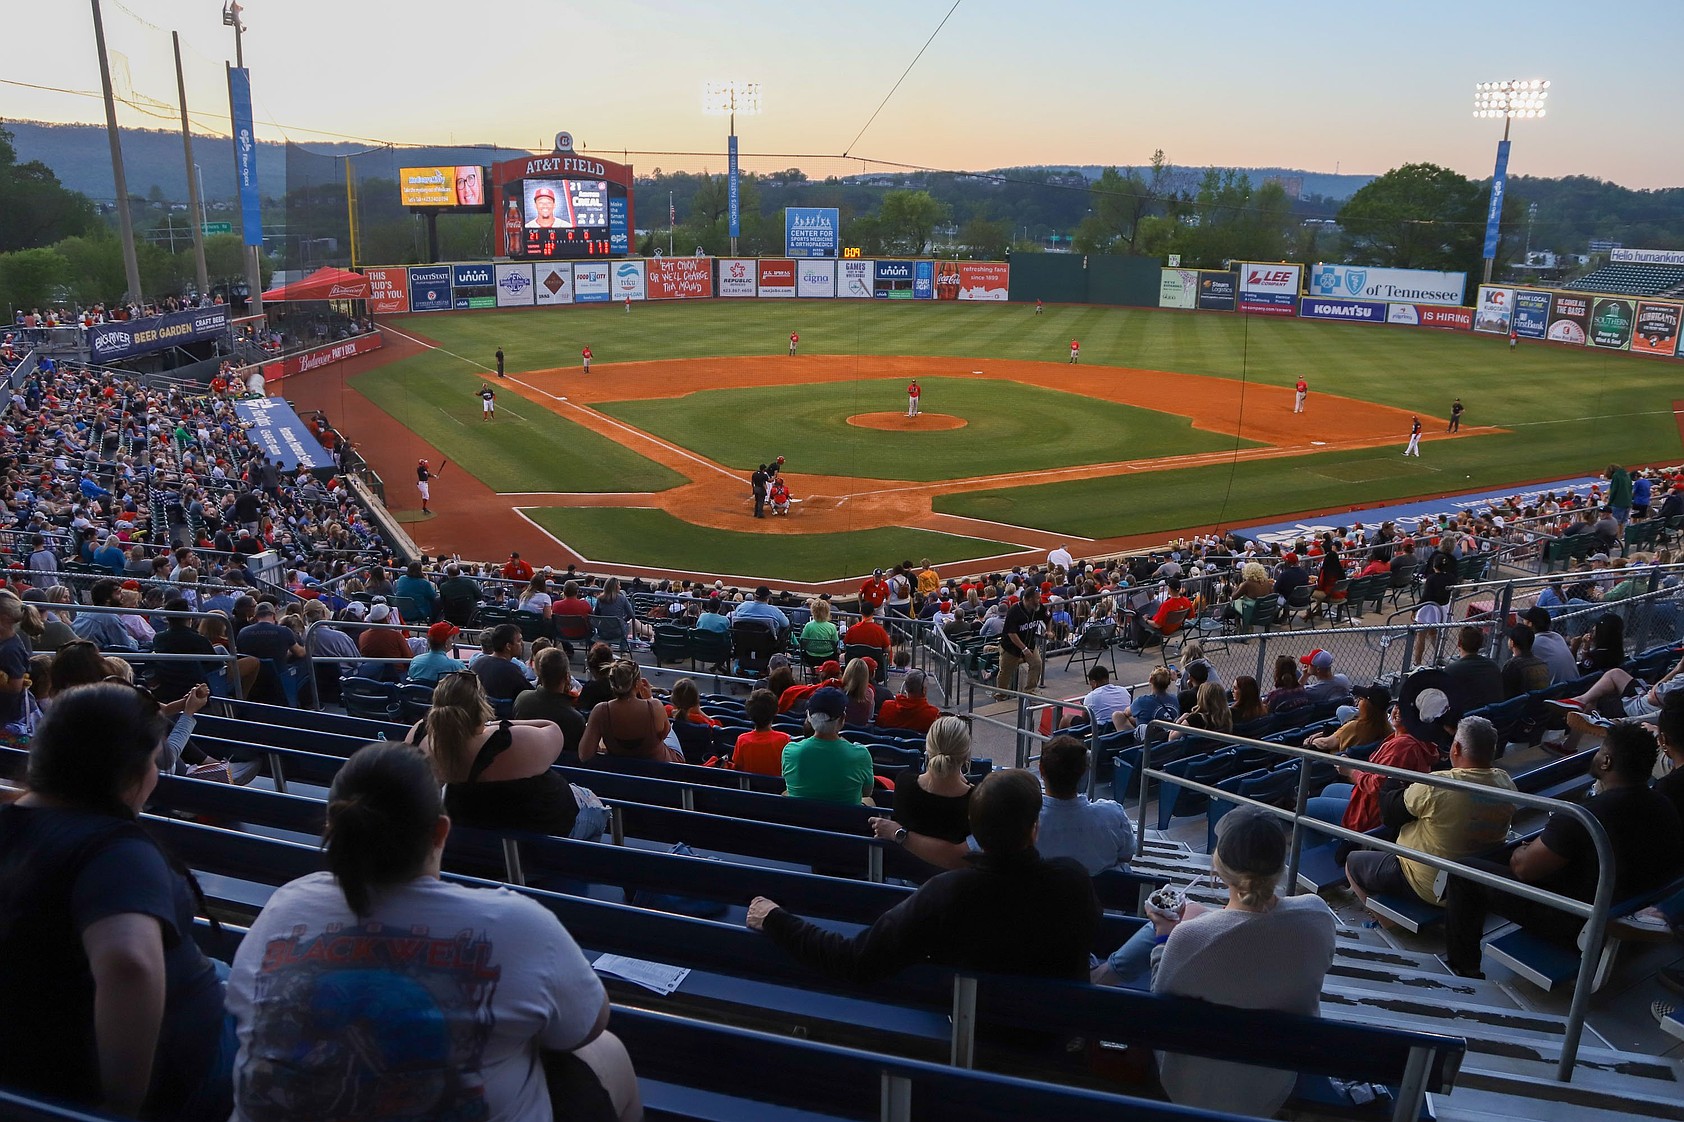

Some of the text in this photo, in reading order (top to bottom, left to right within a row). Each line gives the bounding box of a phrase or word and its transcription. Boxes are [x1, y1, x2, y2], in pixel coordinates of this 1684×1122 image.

[526, 158, 604, 176] AT&T FIELD
[611, 233, 627, 243] epb
[844, 248, 860, 257] 0:09
[1612, 250, 1633, 260] Hello
[661, 262, 674, 270] EAT
[845, 263, 866, 271] GAMES
[881, 266, 908, 276] unum
[964, 266, 993, 274] refreshing
[368, 272, 386, 280] THIS
[459, 270, 488, 282] unum
[650, 271, 708, 282] OR WE'LL CHARGE
[804, 273, 828, 284] cigna
[1264, 271, 1292, 282] LEE
[371, 281, 392, 289] BUD'S
[663, 281, 701, 292] THA MOUND
[387, 290, 404, 298] YOU.
[1366, 285, 1458, 301] of Tennessee
[1486, 290, 1505, 305] KC
[1314, 304, 1372, 317] KOMATSU
[1557, 306, 1586, 316] THE BASES
[195, 316, 224, 327] CRAFT BEER
[1424, 312, 1470, 324] IS HIRING
[1594, 317, 1629, 326] SOUTHERN
[1640, 312, 1677, 325] LUBRICANTS
[1514, 318, 1544, 330] FirstBank
[134, 332, 157, 343] BEER
[159, 323, 192, 339] GARDEN
[95, 333, 108, 350] BIG
[108, 332, 131, 344] RIVER
[299, 353, 331, 371] Budweiser
[345, 343, 356, 355] DECK
